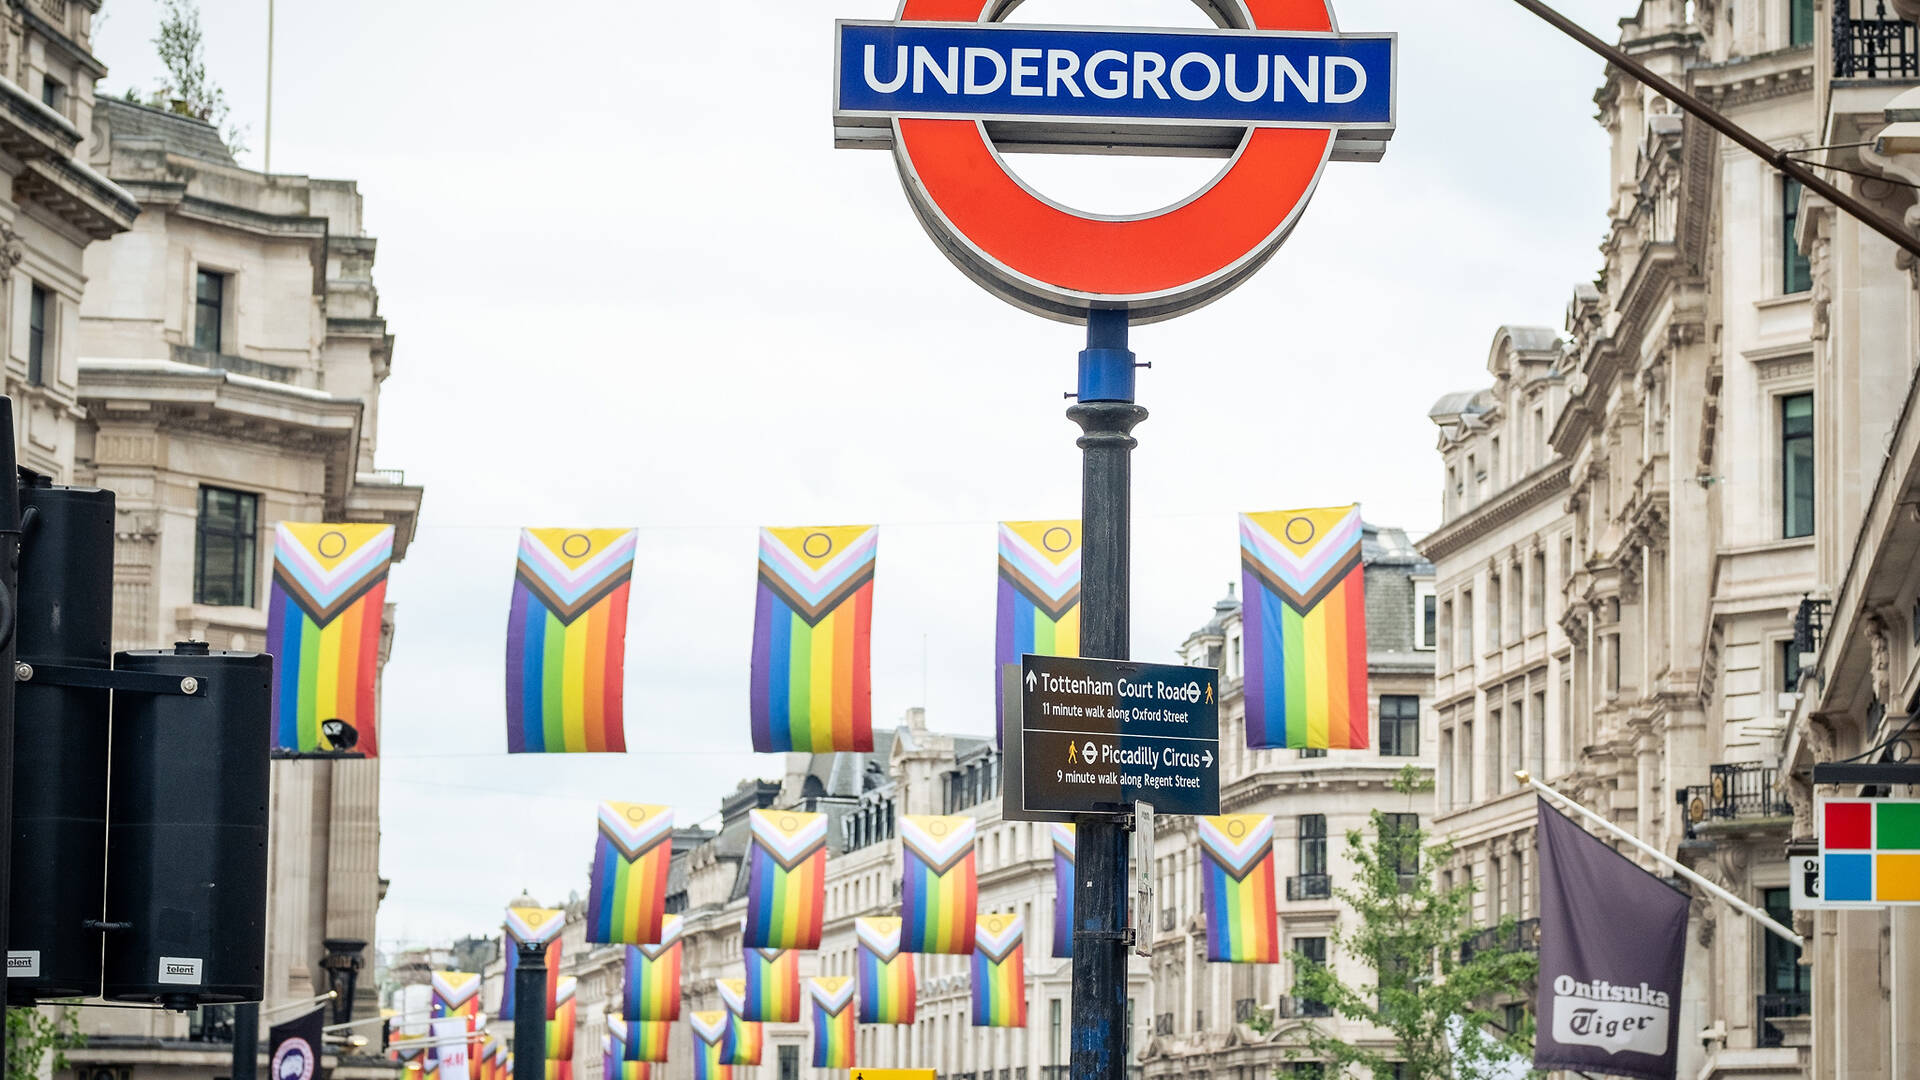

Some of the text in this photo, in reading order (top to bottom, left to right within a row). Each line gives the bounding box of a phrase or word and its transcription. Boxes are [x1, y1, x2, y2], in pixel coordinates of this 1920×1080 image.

[863, 44, 1367, 103] UNDERGROUND
[1041, 672, 1187, 701] Tottenham Court Road
[1042, 702, 1189, 723] 11 minute walk along Oxford Street
[1102, 744, 1200, 770] Piccadilly Circus
[1056, 769, 1200, 789] 9 minute walk along Regent Street
[8, 958, 32, 967] elent
[167, 965, 194, 974] telent
[1553, 974, 1670, 1009] Onitsuka
[1569, 1007, 1655, 1038] Tiger
